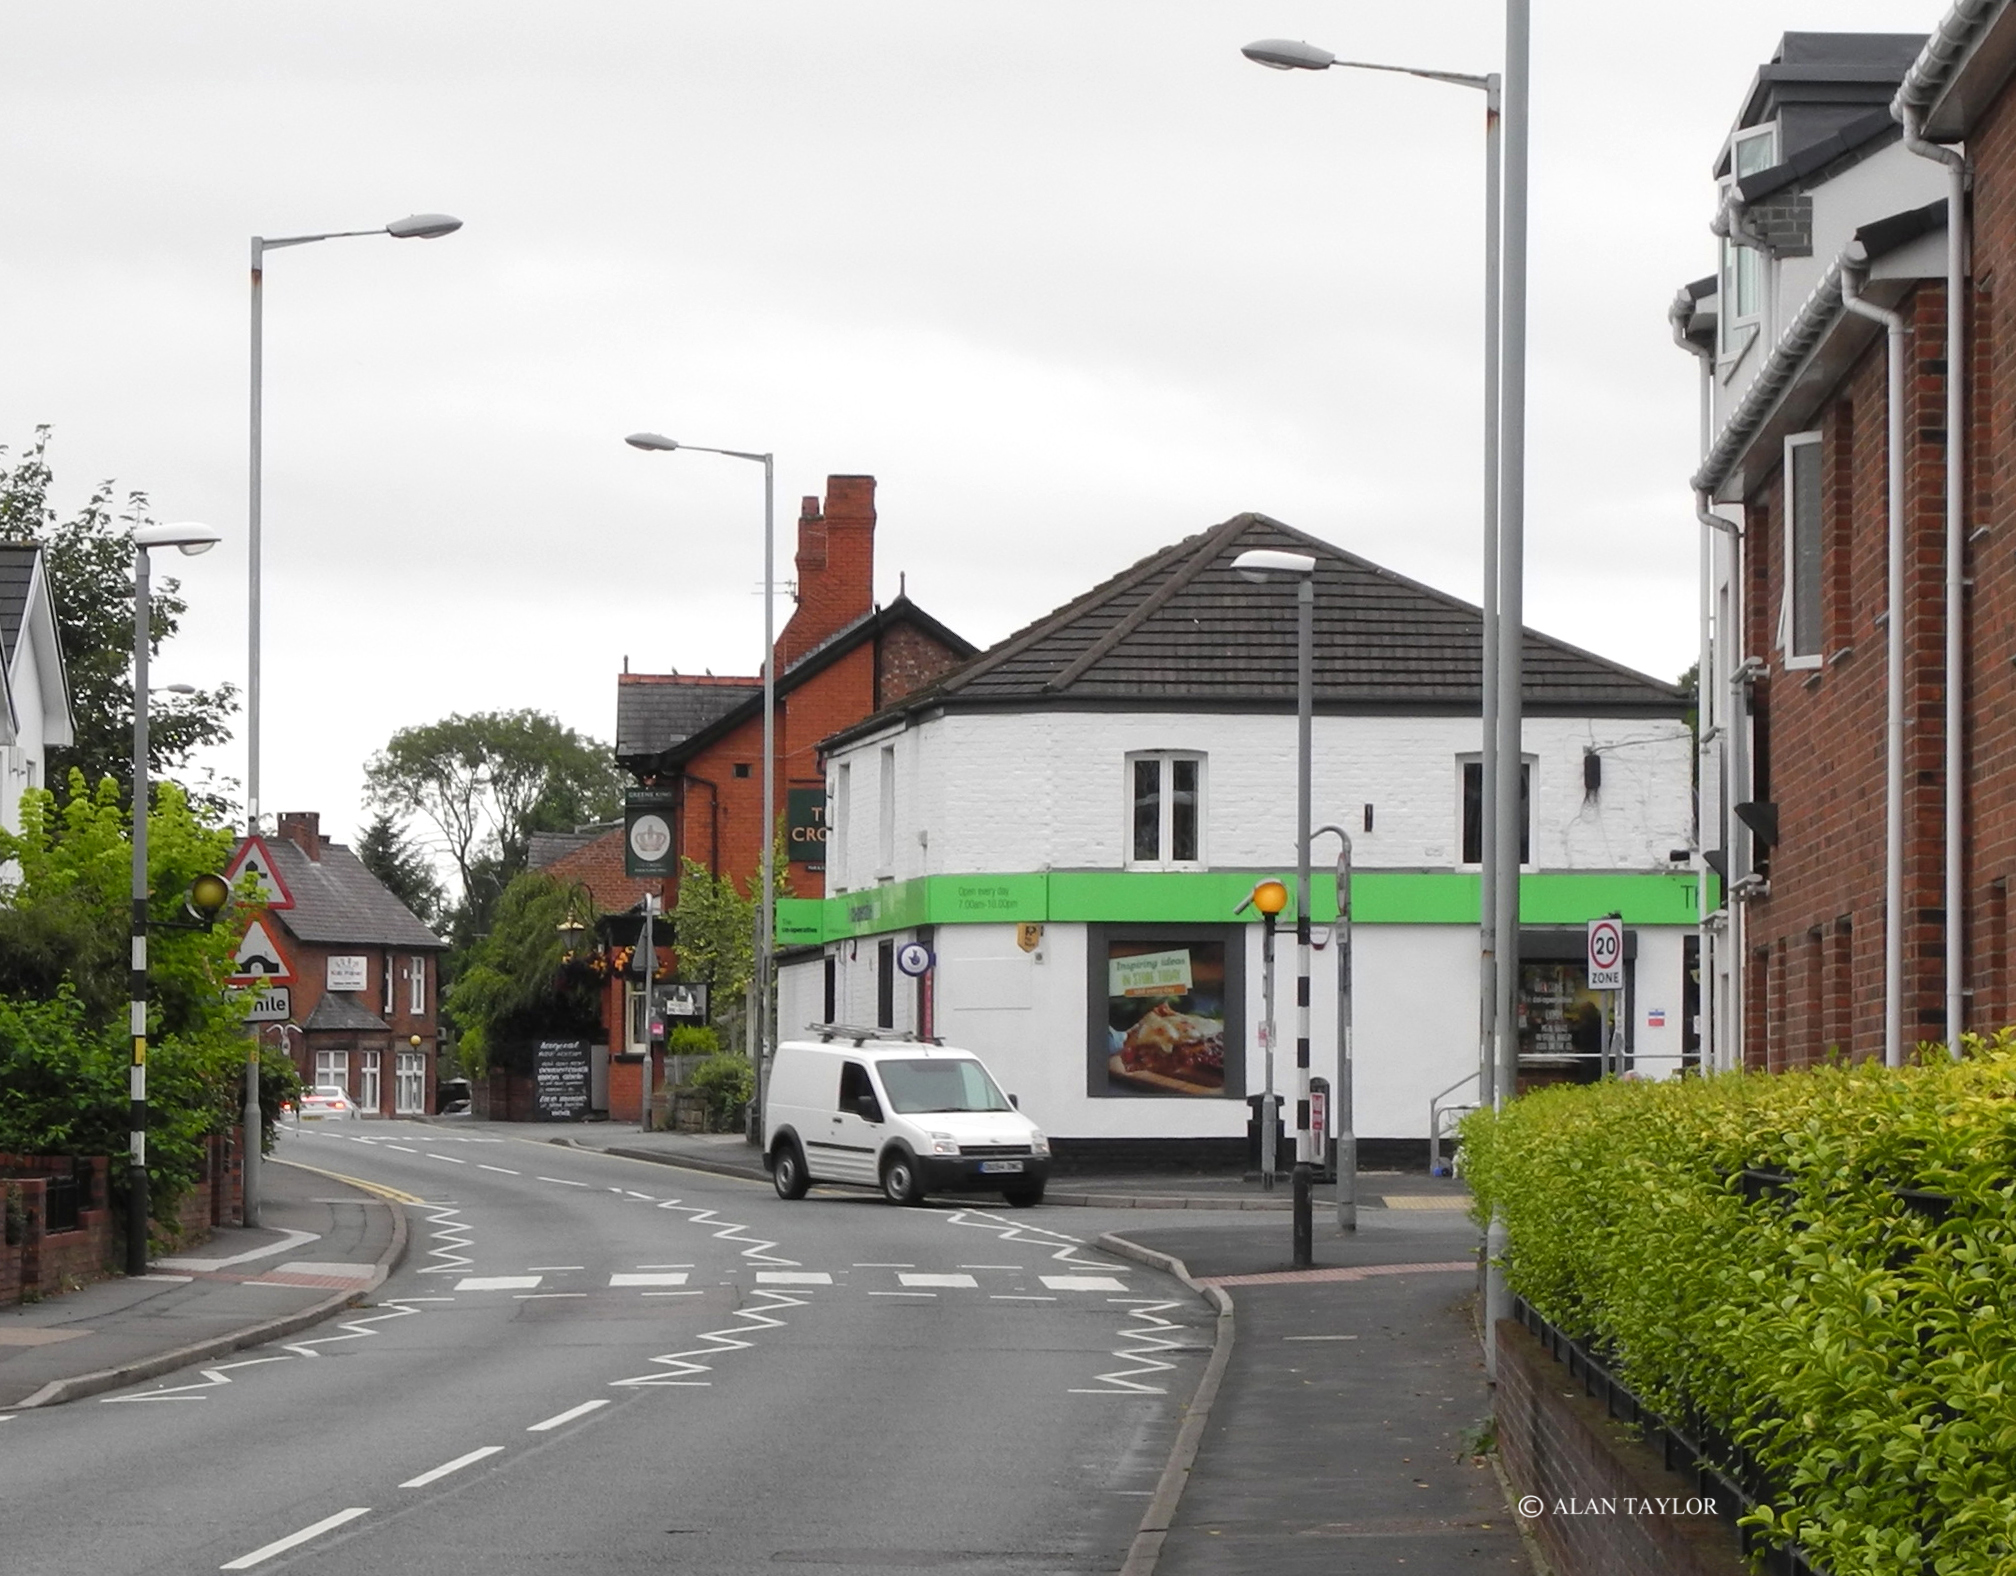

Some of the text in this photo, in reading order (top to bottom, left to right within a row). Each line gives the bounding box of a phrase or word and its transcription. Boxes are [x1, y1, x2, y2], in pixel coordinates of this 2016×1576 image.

[792, 827, 826, 842] CRO
[958, 886, 976, 896] Open
[1596, 936, 1616, 955] 20
[1116, 956, 1186, 972] Inspiring ideas
[1592, 972, 1619, 984] ZONE
